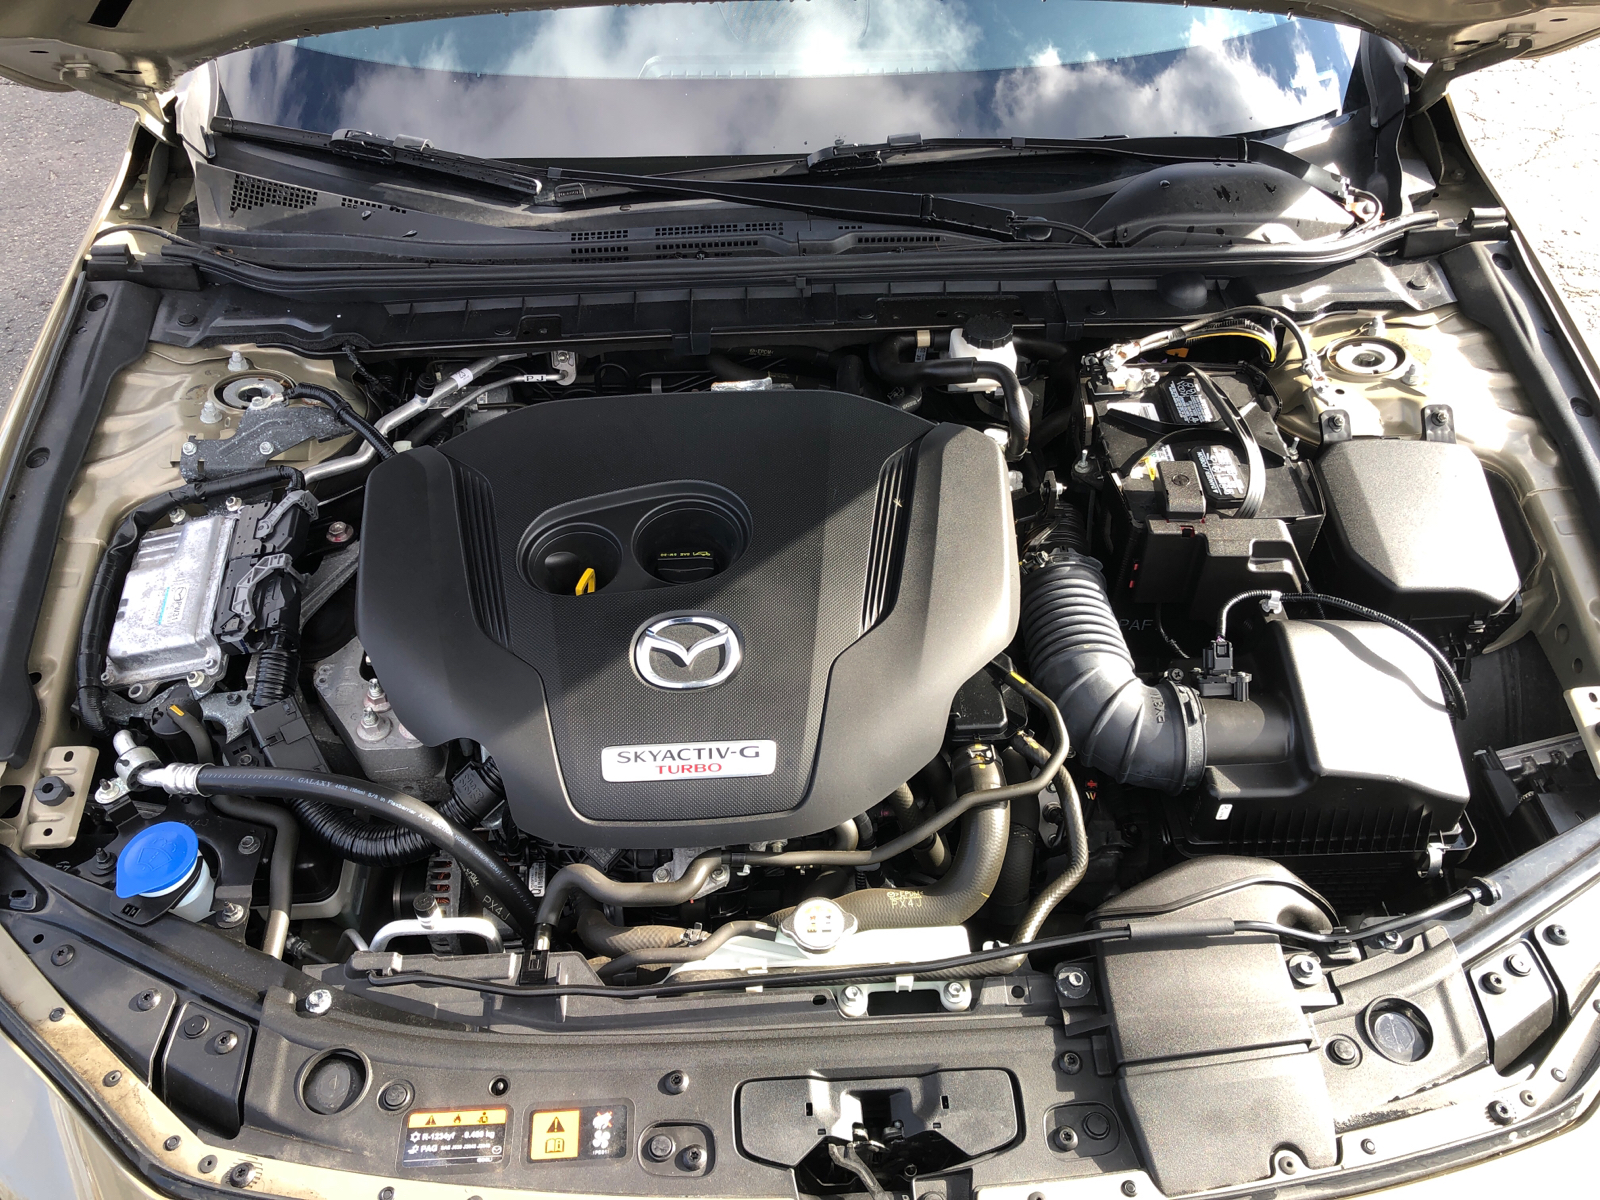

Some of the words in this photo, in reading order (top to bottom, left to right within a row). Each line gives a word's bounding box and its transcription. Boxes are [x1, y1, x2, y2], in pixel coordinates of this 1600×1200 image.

[617, 745, 760, 764] SKYACTIV-G
[655, 763, 722, 774] TURBO
[298, 777, 333, 788] GALAXY
[417, 813, 431, 822] A/C
[454, 835, 468, 847] HOSE
[482, 895, 511, 921] PX4J
[891, 898, 922, 909] PX4J
[485, 1130, 496, 1139] kg
[420, 1145, 438, 1153] PAG
